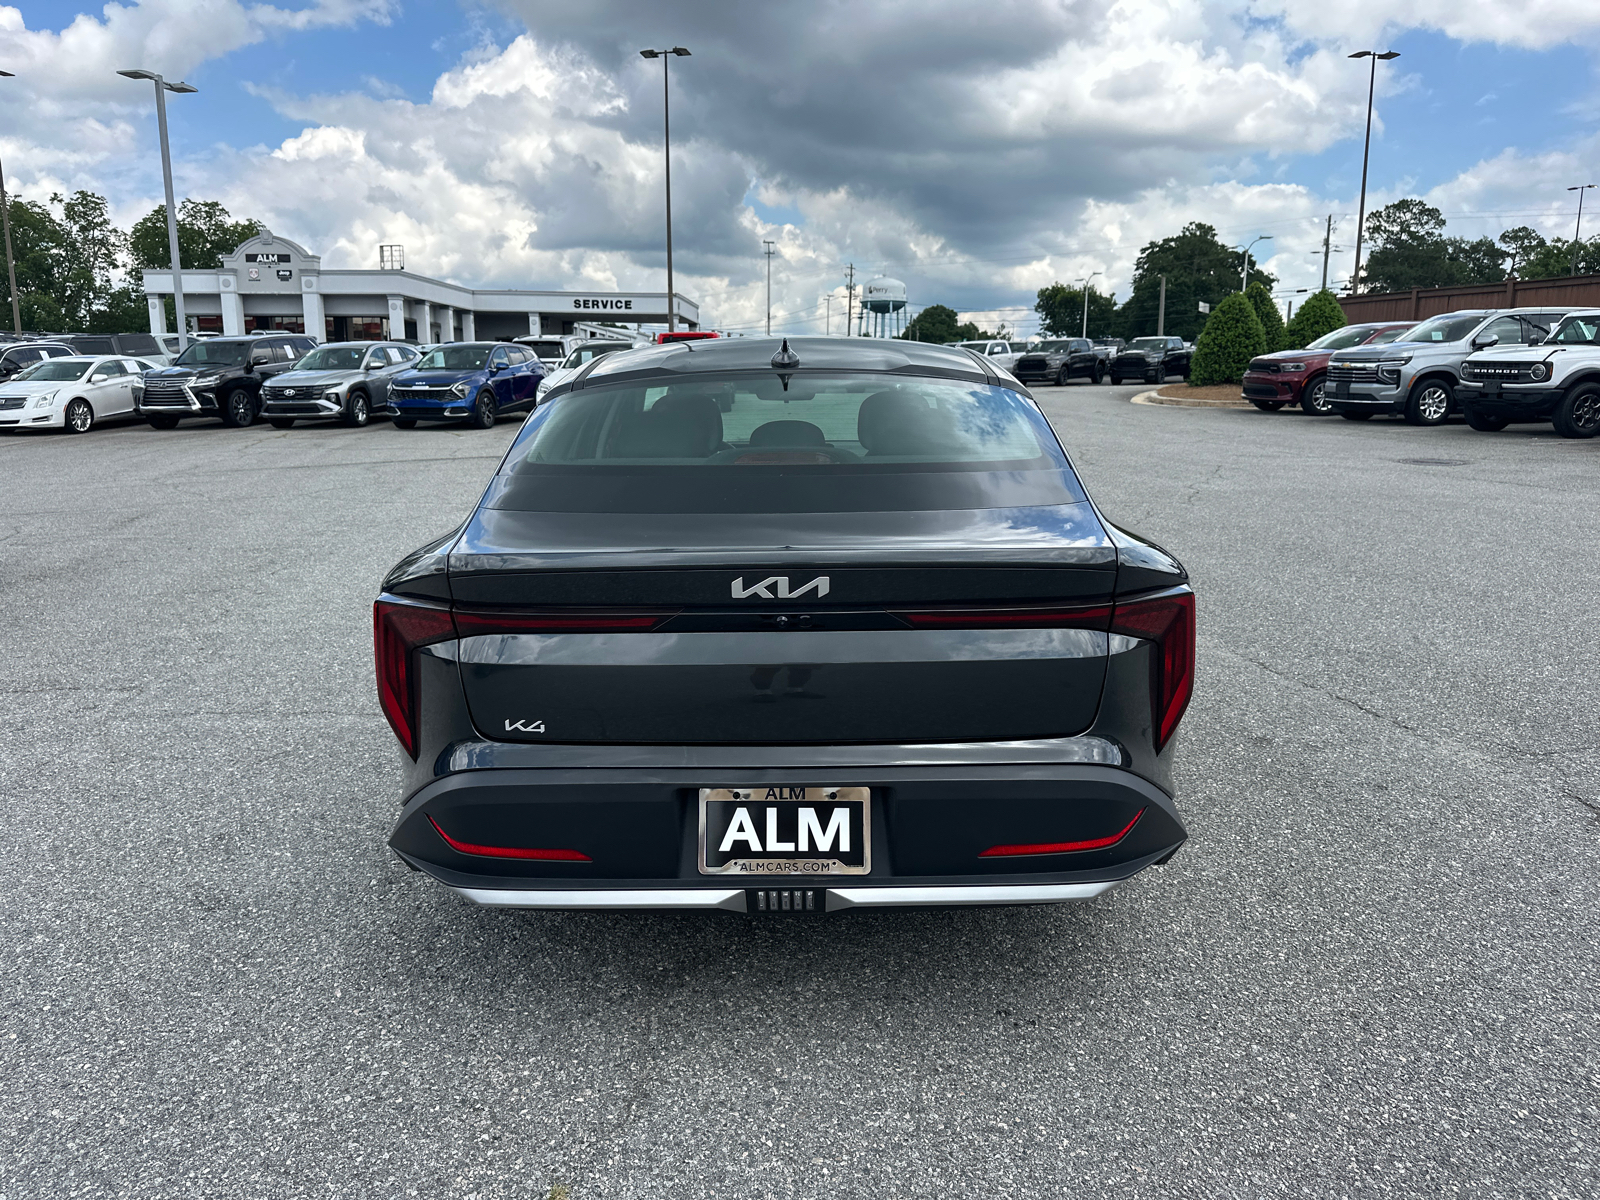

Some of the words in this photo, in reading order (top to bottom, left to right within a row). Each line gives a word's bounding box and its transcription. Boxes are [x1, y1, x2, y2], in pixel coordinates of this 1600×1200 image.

[256, 254, 278, 262] ALM
[872, 286, 888, 294] Perry
[574, 299, 632, 310] SERVICE
[731, 576, 830, 599] KIA
[504, 718, 546, 734] K4
[765, 787, 806, 800] ALM
[718, 807, 851, 852] ALM
[739, 862, 831, 872] ALMCARS.COM
